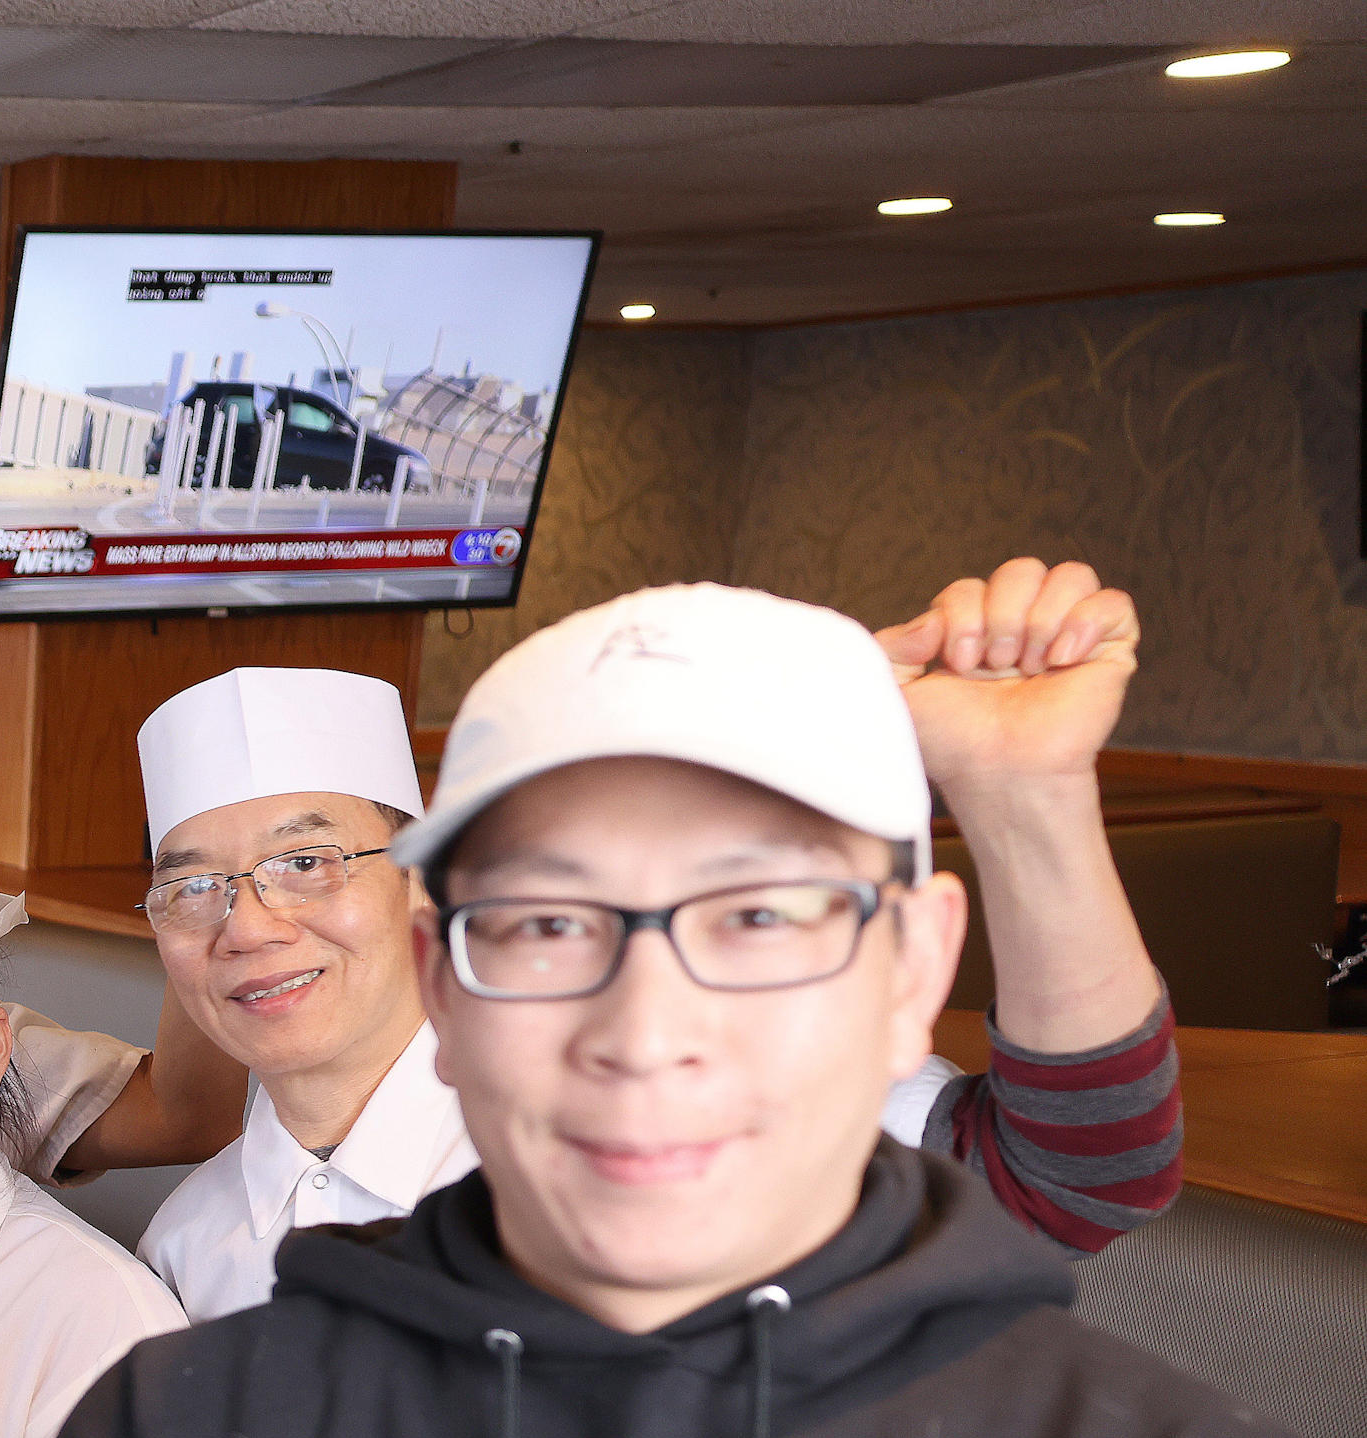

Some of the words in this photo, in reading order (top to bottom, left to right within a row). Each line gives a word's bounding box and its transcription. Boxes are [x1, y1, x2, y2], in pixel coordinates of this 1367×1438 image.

[164, 270, 195, 285] dump
[243, 270, 270, 283] that
[168, 287, 192, 300] off
[13, 549, 96, 574] NEWS
[106, 545, 139, 565] MASS
[138, 545, 164, 564] PIKE
[186, 543, 219, 562] RAMP
[231, 542, 278, 561] ALLSTON
[278, 541, 328, 560] REOPENS
[327, 540, 385, 559] FOLLOWING
[385, 539, 412, 558] WILD
[411, 538, 448, 558] WRECK
